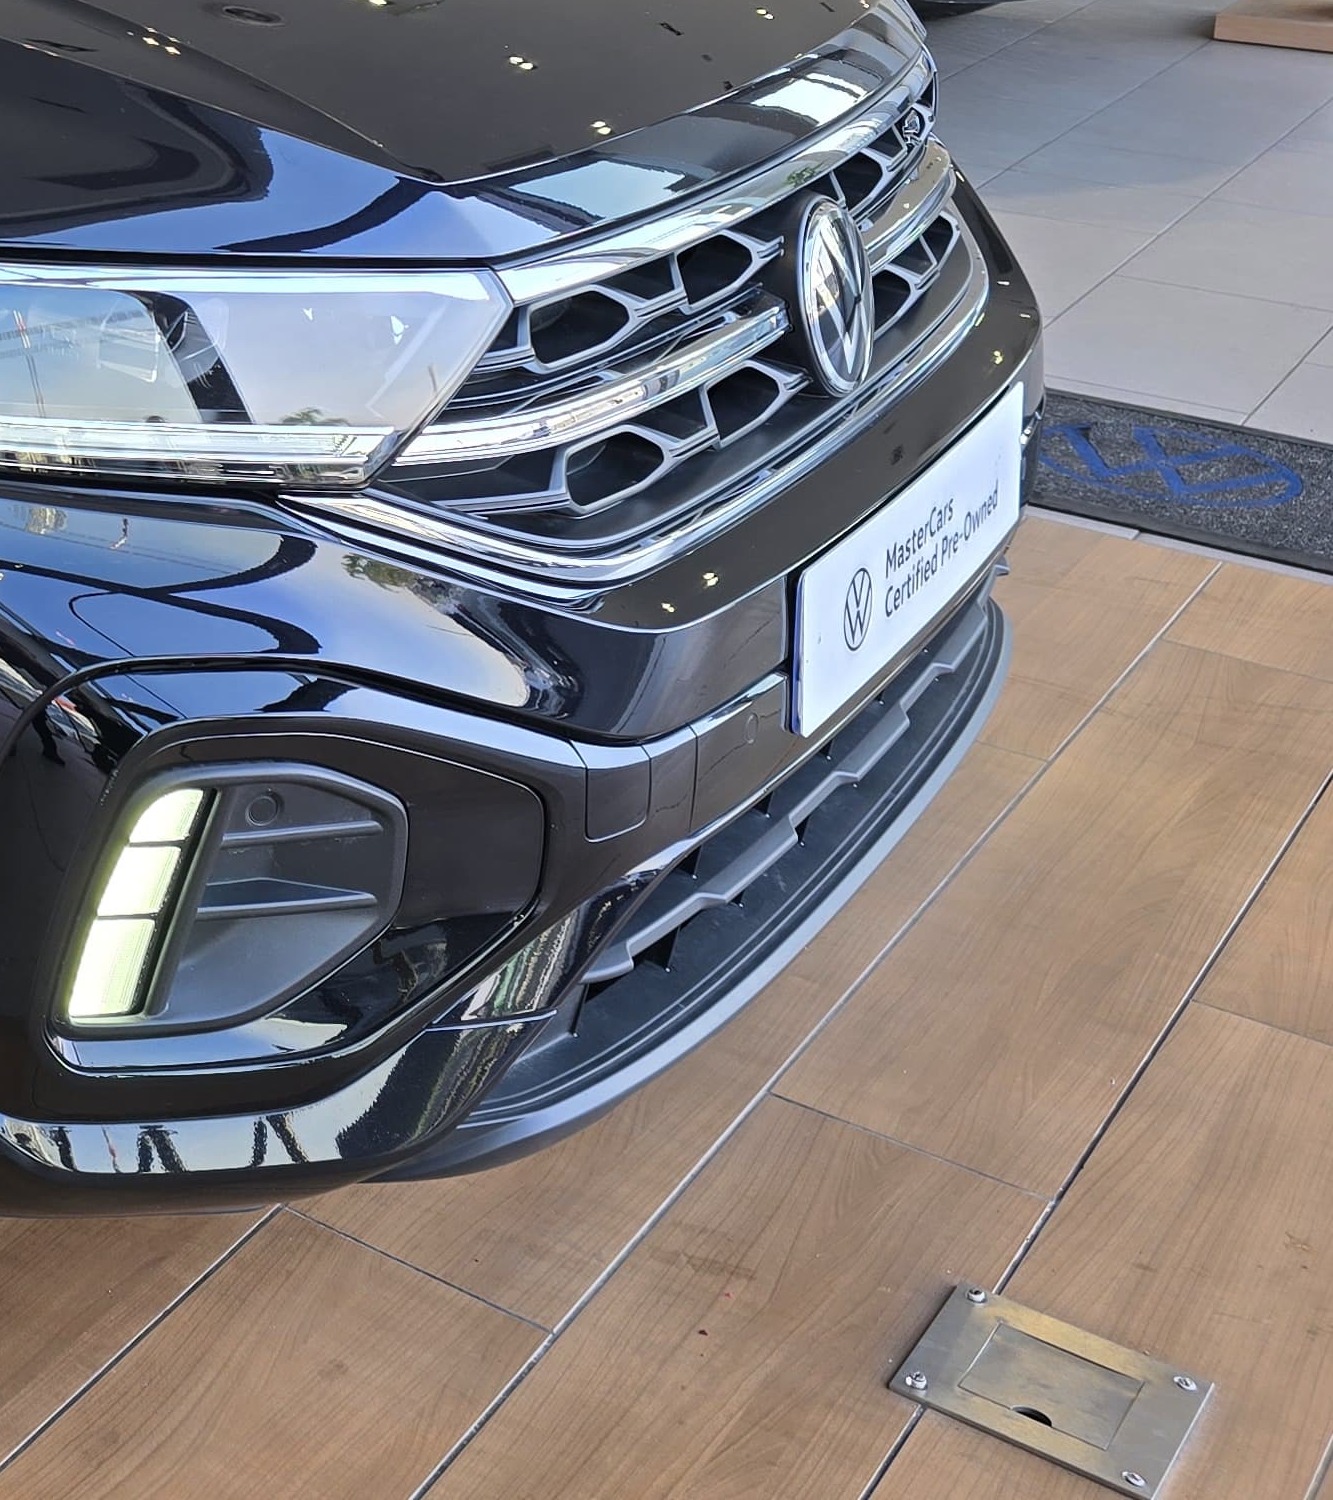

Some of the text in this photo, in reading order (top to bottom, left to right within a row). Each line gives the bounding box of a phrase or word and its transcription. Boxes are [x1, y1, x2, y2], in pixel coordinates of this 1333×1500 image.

[884, 477, 1000, 618] Certified Pre-Owned
[885, 498, 954, 579] MasterCars
